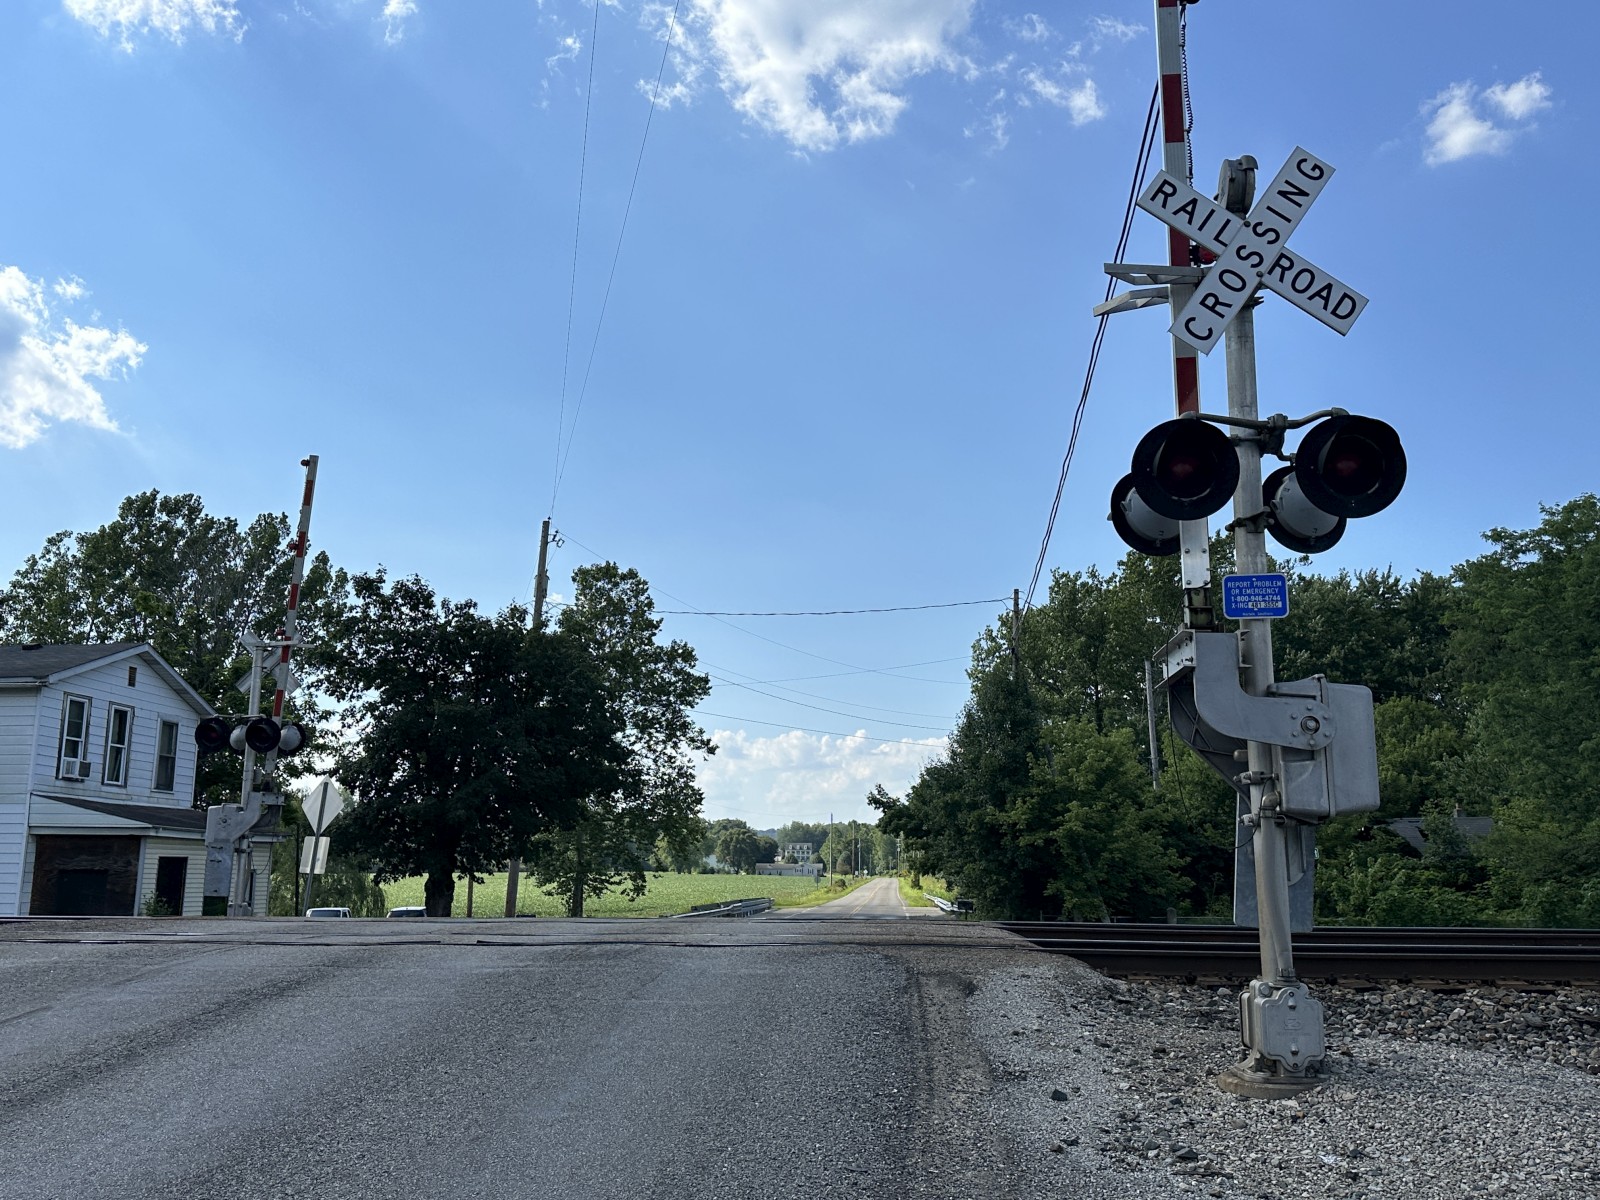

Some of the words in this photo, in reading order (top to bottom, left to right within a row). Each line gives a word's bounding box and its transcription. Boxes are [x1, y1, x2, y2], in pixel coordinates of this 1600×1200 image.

[1149, 178, 1231, 248] RAIL
[1267, 252, 1357, 320] ROAD
[1184, 157, 1325, 342] CROSSING
